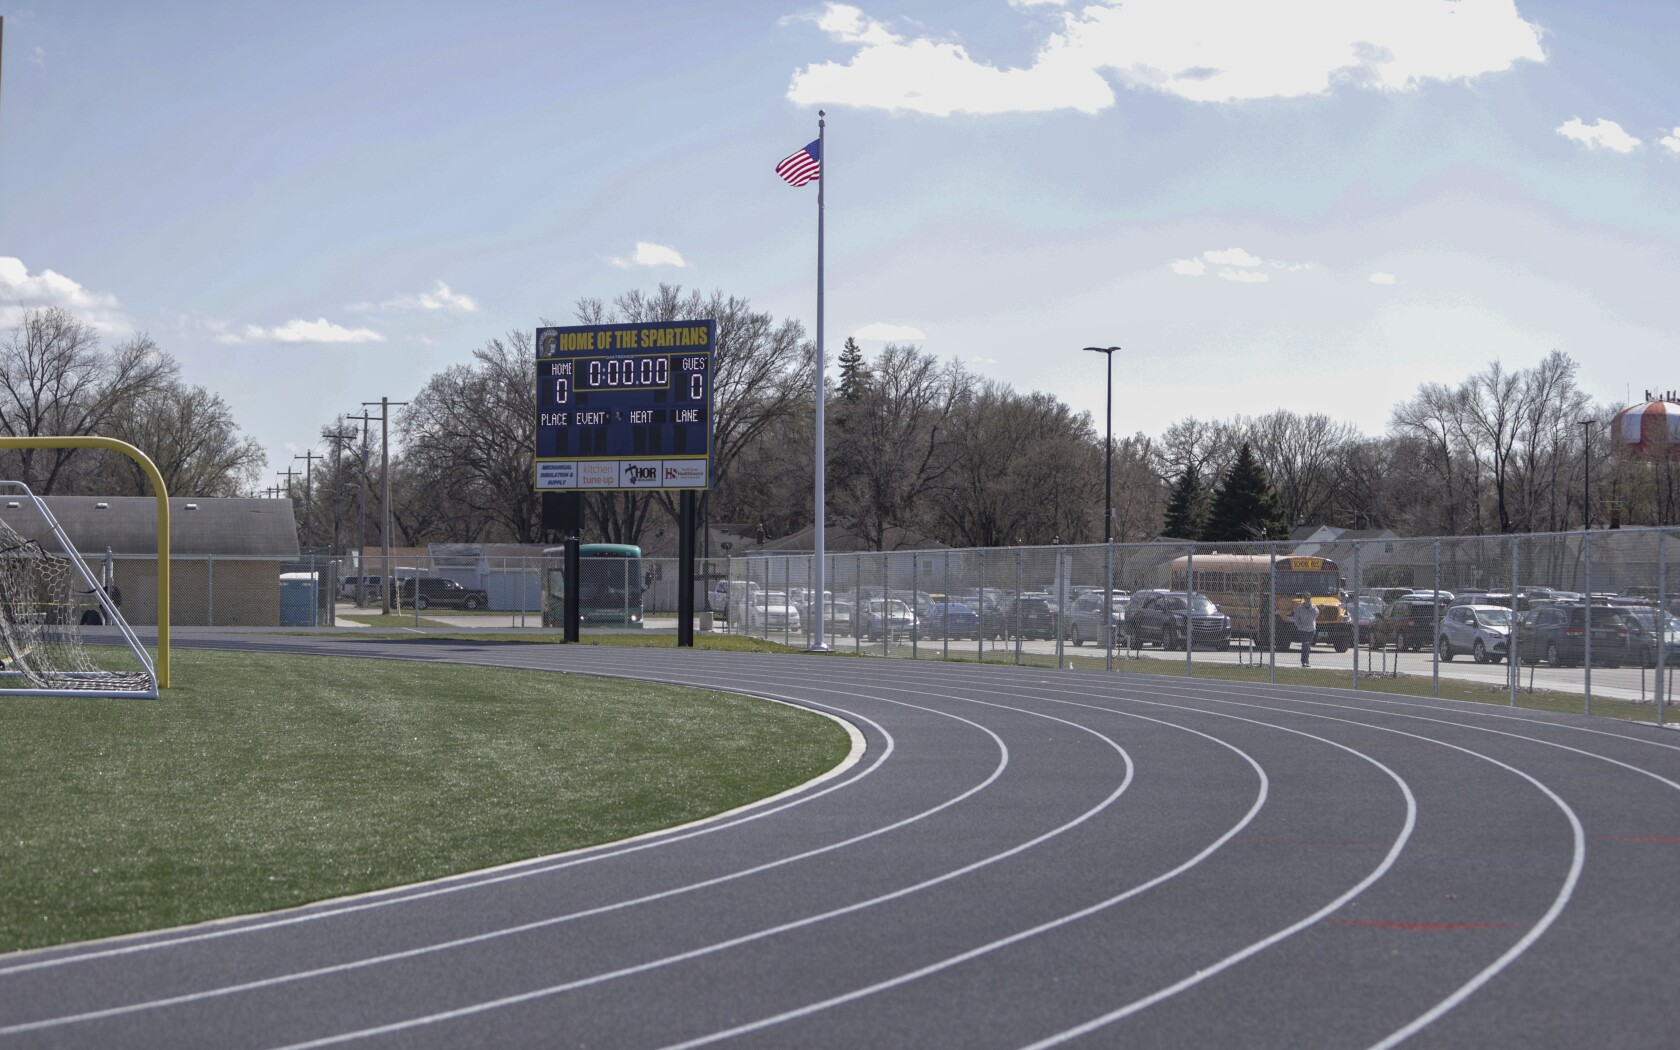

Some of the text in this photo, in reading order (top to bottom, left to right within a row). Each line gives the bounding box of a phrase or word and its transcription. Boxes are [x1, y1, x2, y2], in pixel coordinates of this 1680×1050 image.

[559, 326, 708, 351] HOME OF THE SPARTANS
[551, 362, 572, 376] HOME
[556, 379, 568, 404] 0
[690, 373, 703, 400] 0
[541, 413, 568, 426] PLACE
[576, 412, 605, 425] EVENT
[630, 410, 654, 424] HEAT
[675, 409, 699, 422] LANE
[583, 464, 613, 474] kitchen
[583, 476, 614, 485] tune-up
[1293, 560, 1320, 568] SCHOOL BUS
